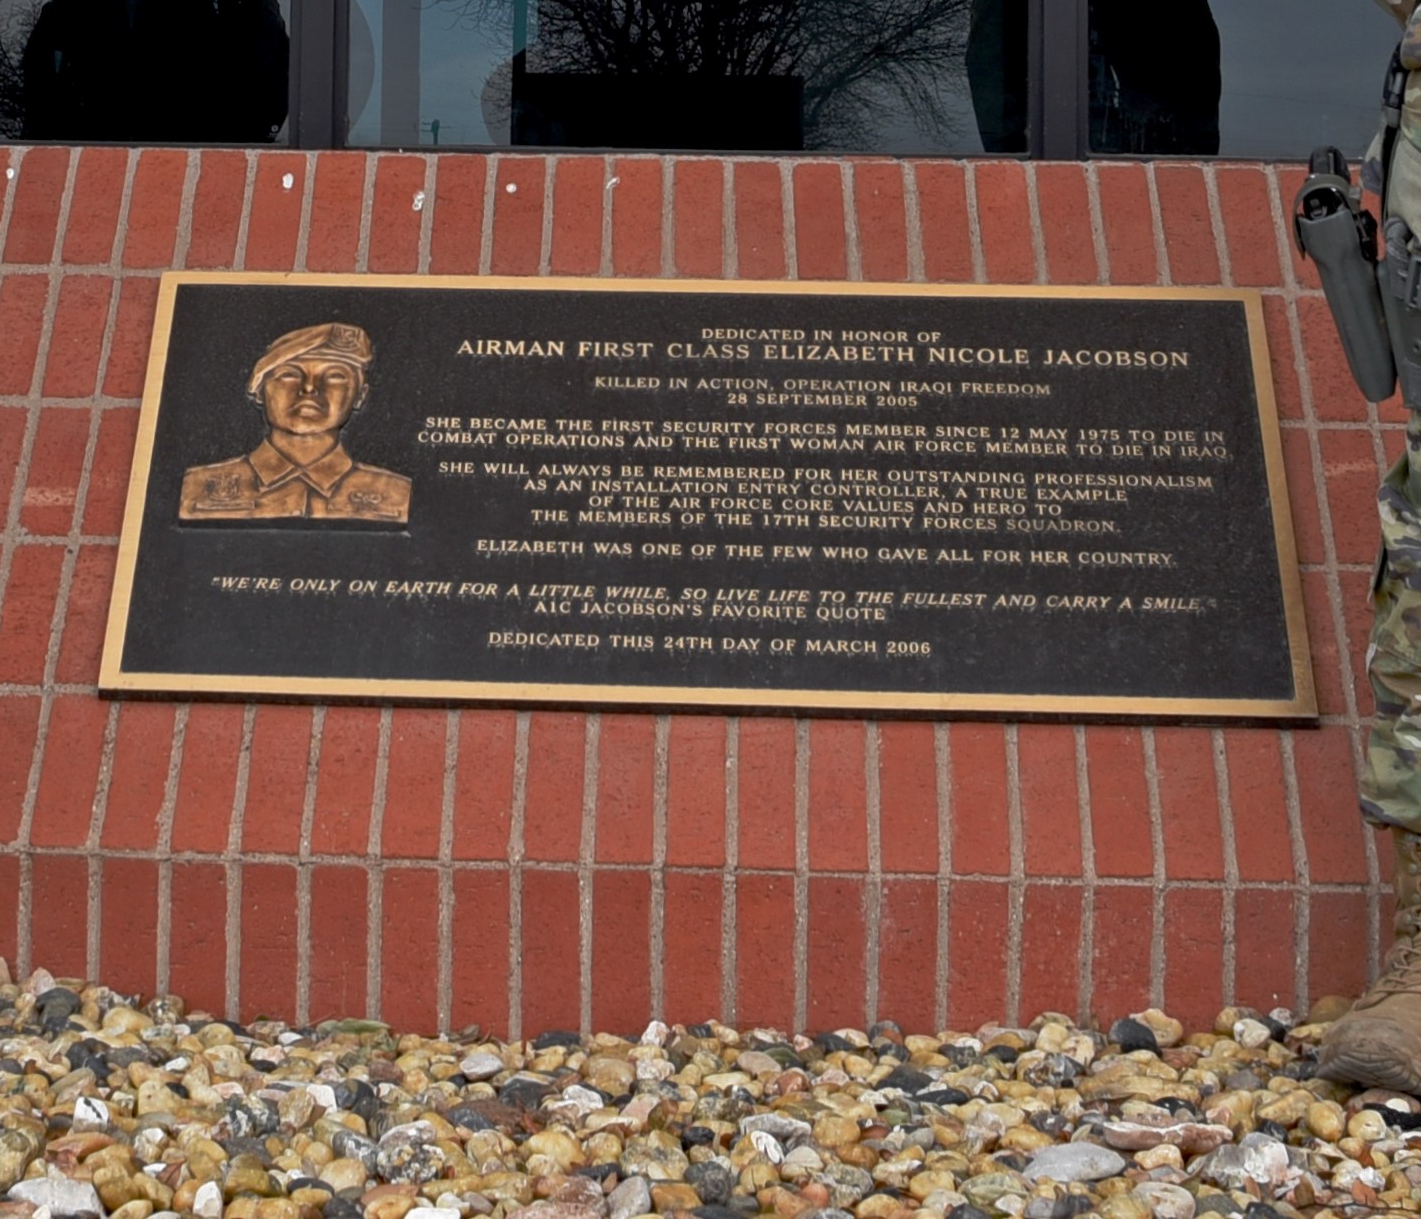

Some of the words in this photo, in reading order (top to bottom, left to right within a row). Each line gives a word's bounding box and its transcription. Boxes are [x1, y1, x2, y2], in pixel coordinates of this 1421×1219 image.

[701, 328, 806, 340] DEDICATED
[814, 329, 833, 341] IN
[841, 330, 909, 342] HONOR
[916, 331, 941, 342] OF
[456, 338, 565, 357] AIRMAN
[578, 341, 654, 358] FIRST
[666, 342, 750, 359] CLASS
[763, 343, 915, 362] ELIZABETH
[928, 347, 1030, 364] NICOLE
[1043, 349, 1188, 367] JACOBSON
[594, 376, 661, 388] KILLED
[669, 377, 688, 389] IN
[783, 378, 891, 391] OPERATION
[900, 381, 952, 394] IRAQI
[961, 382, 1051, 394] FREEDOM
[727, 393, 748, 404] 28
[755, 392, 868, 406] SEPTEMBER
[876, 395, 918, 406] 2005
[425, 416, 462, 428] SHE
[469, 417, 547, 430] BECAME
[555, 419, 593, 430] THE
[601, 419, 654, 431] FIRST
[662, 420, 755, 433] SECURITY
[764, 422, 837, 435] FORCES
[845, 424, 927, 436] MEMBER
[935, 426, 991, 438] SINCE
[1001, 427, 1020, 438] 12
[1029, 427, 1068, 439] MAY
[1079, 428, 1120, 440] 1975
[1128, 430, 1155, 441] TO
[1164, 431, 1195, 441] DIE
[1204, 431, 1223, 441] IN
[417, 430, 498, 443] COMBAT
[505, 432, 625, 447] OPERATIONS
[633, 435, 674, 447] AND
[681, 436, 720, 447] THE
[728, 437, 782, 449] FIRST
[789, 438, 865, 450] WOMAN
[873, 439, 906, 451] AIR
[914, 440, 977, 452] FORCE
[985, 441, 1068, 454] MEMBER
[1075, 444, 1103, 455] TO
[1112, 445, 1144, 455] DIE
[1152, 445, 1171, 456] IN
[438, 461, 475, 473] SHE
[483, 462, 530, 474] WILL
[538, 463, 612, 476] ALWAYS
[620, 465, 645, 476] BE
[653, 465, 786, 479] REMEMBERED
[794, 467, 833, 480] FOR
[840, 468, 879, 482] HER
[887, 470, 1025, 484] OUTSTANDING
[1034, 473, 1213, 487] PROFESSIONALISM
[523, 478, 548, 491] AS
[555, 479, 582, 491] AN
[591, 478, 729, 494] INSTALLATION
[738, 482, 801, 494] ENTRY
[955, 487, 968, 498] A
[976, 487, 1028, 499] TRUE
[1036, 487, 1128, 501] EXAMPLE
[588, 495, 614, 506] OF
[621, 495, 660, 508] THE
[668, 496, 701, 508] AIR
[710, 497, 773, 509] FORCE
[781, 498, 834, 510] CORE
[842, 500, 915, 512] VALUES
[923, 501, 964, 513] AND
[973, 502, 1026, 514] HERO
[1034, 503, 1062, 515] TO
[530, 509, 569, 521] THE
[578, 510, 672, 523] MEMBERS
[680, 511, 706, 524] OF
[713, 512, 753, 525] THE
[763, 514, 810, 526] 17TH
[818, 514, 913, 529] SECURITY
[923, 517, 997, 529] FORCES
[476, 539, 584, 554] ELIZABETH
[593, 541, 633, 554] WAS
[641, 543, 682, 555] ONE
[690, 544, 717, 555] OF
[724, 544, 764, 556] THE
[773, 545, 813, 557] FEW
[822, 546, 869, 558] WHO
[877, 547, 928, 559] GAVE
[935, 549, 974, 561] ALL
[982, 549, 1022, 562] FOR
[1030, 550, 1070, 563] HER
[287, 578, 343, 591] ONLY
[346, 580, 379, 592] ON
[383, 580, 453, 594] EARTH
[456, 582, 501, 595] FOR
[504, 583, 523, 595] A
[527, 583, 598, 597] LITTLE
[679, 588, 710, 599] SO
[714, 587, 762, 600] LIVE
[766, 589, 813, 601] LIFE
[816, 590, 848, 602] TO
[853, 590, 896, 603] THE
[901, 591, 989, 605] FULLEST
[993, 593, 1039, 606] AND
[1044, 595, 1113, 608] CARRY
[1117, 596, 1136, 608] A
[580, 601, 703, 616] JACOBSON'S
[711, 603, 807, 618] FAVORITE
[815, 605, 886, 621] QUOTE
[487, 631, 600, 647] DEDICATED
[608, 634, 655, 648] THIS
[663, 635, 713, 649] 24TH
[722, 637, 761, 650] DAY
[769, 638, 797, 651] OF
[805, 639, 877, 653] MARCH
[886, 641, 931, 653] 2006
